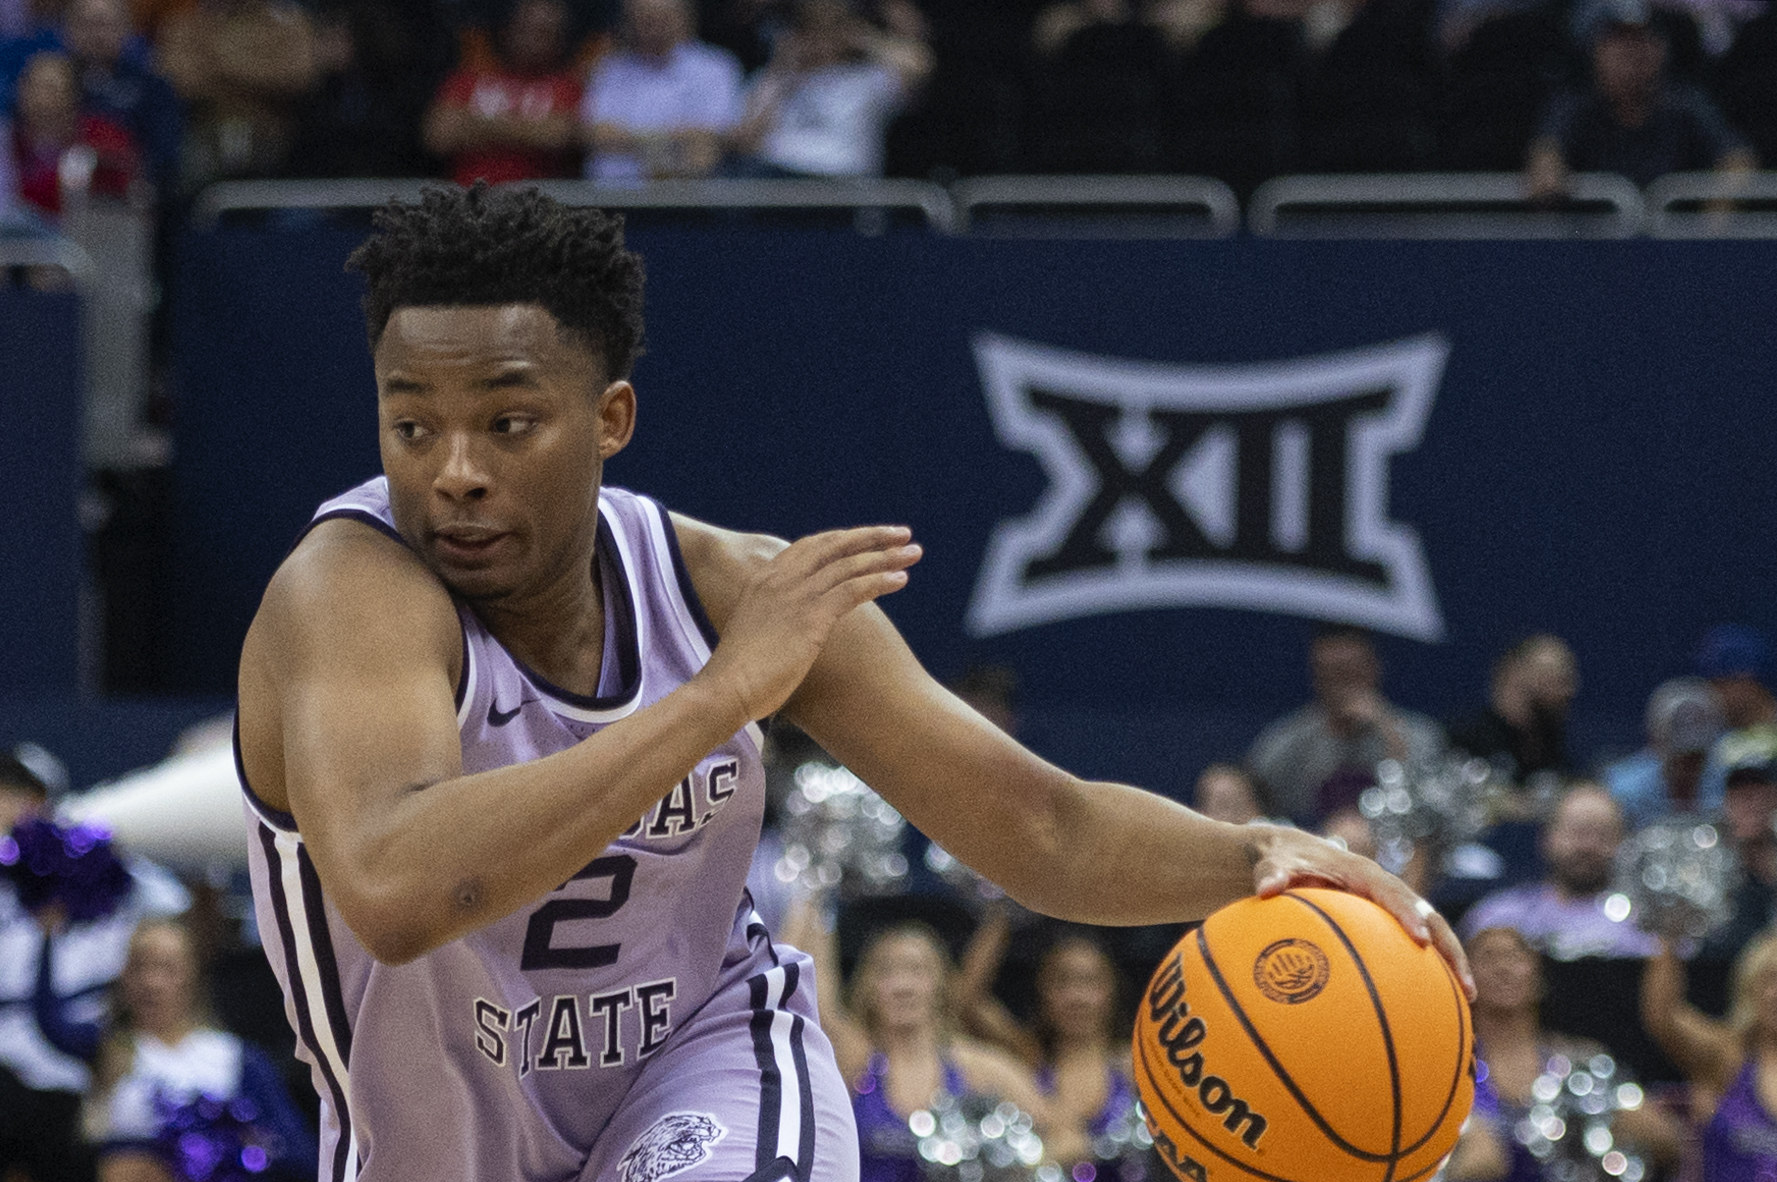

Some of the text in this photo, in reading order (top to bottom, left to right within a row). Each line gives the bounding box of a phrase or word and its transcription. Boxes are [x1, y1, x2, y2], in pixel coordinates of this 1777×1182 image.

[1012, 378, 1406, 598] XII
[520, 854, 639, 973] 2
[472, 976, 677, 1080] STATE
[1148, 951, 1270, 1152] Wilson
